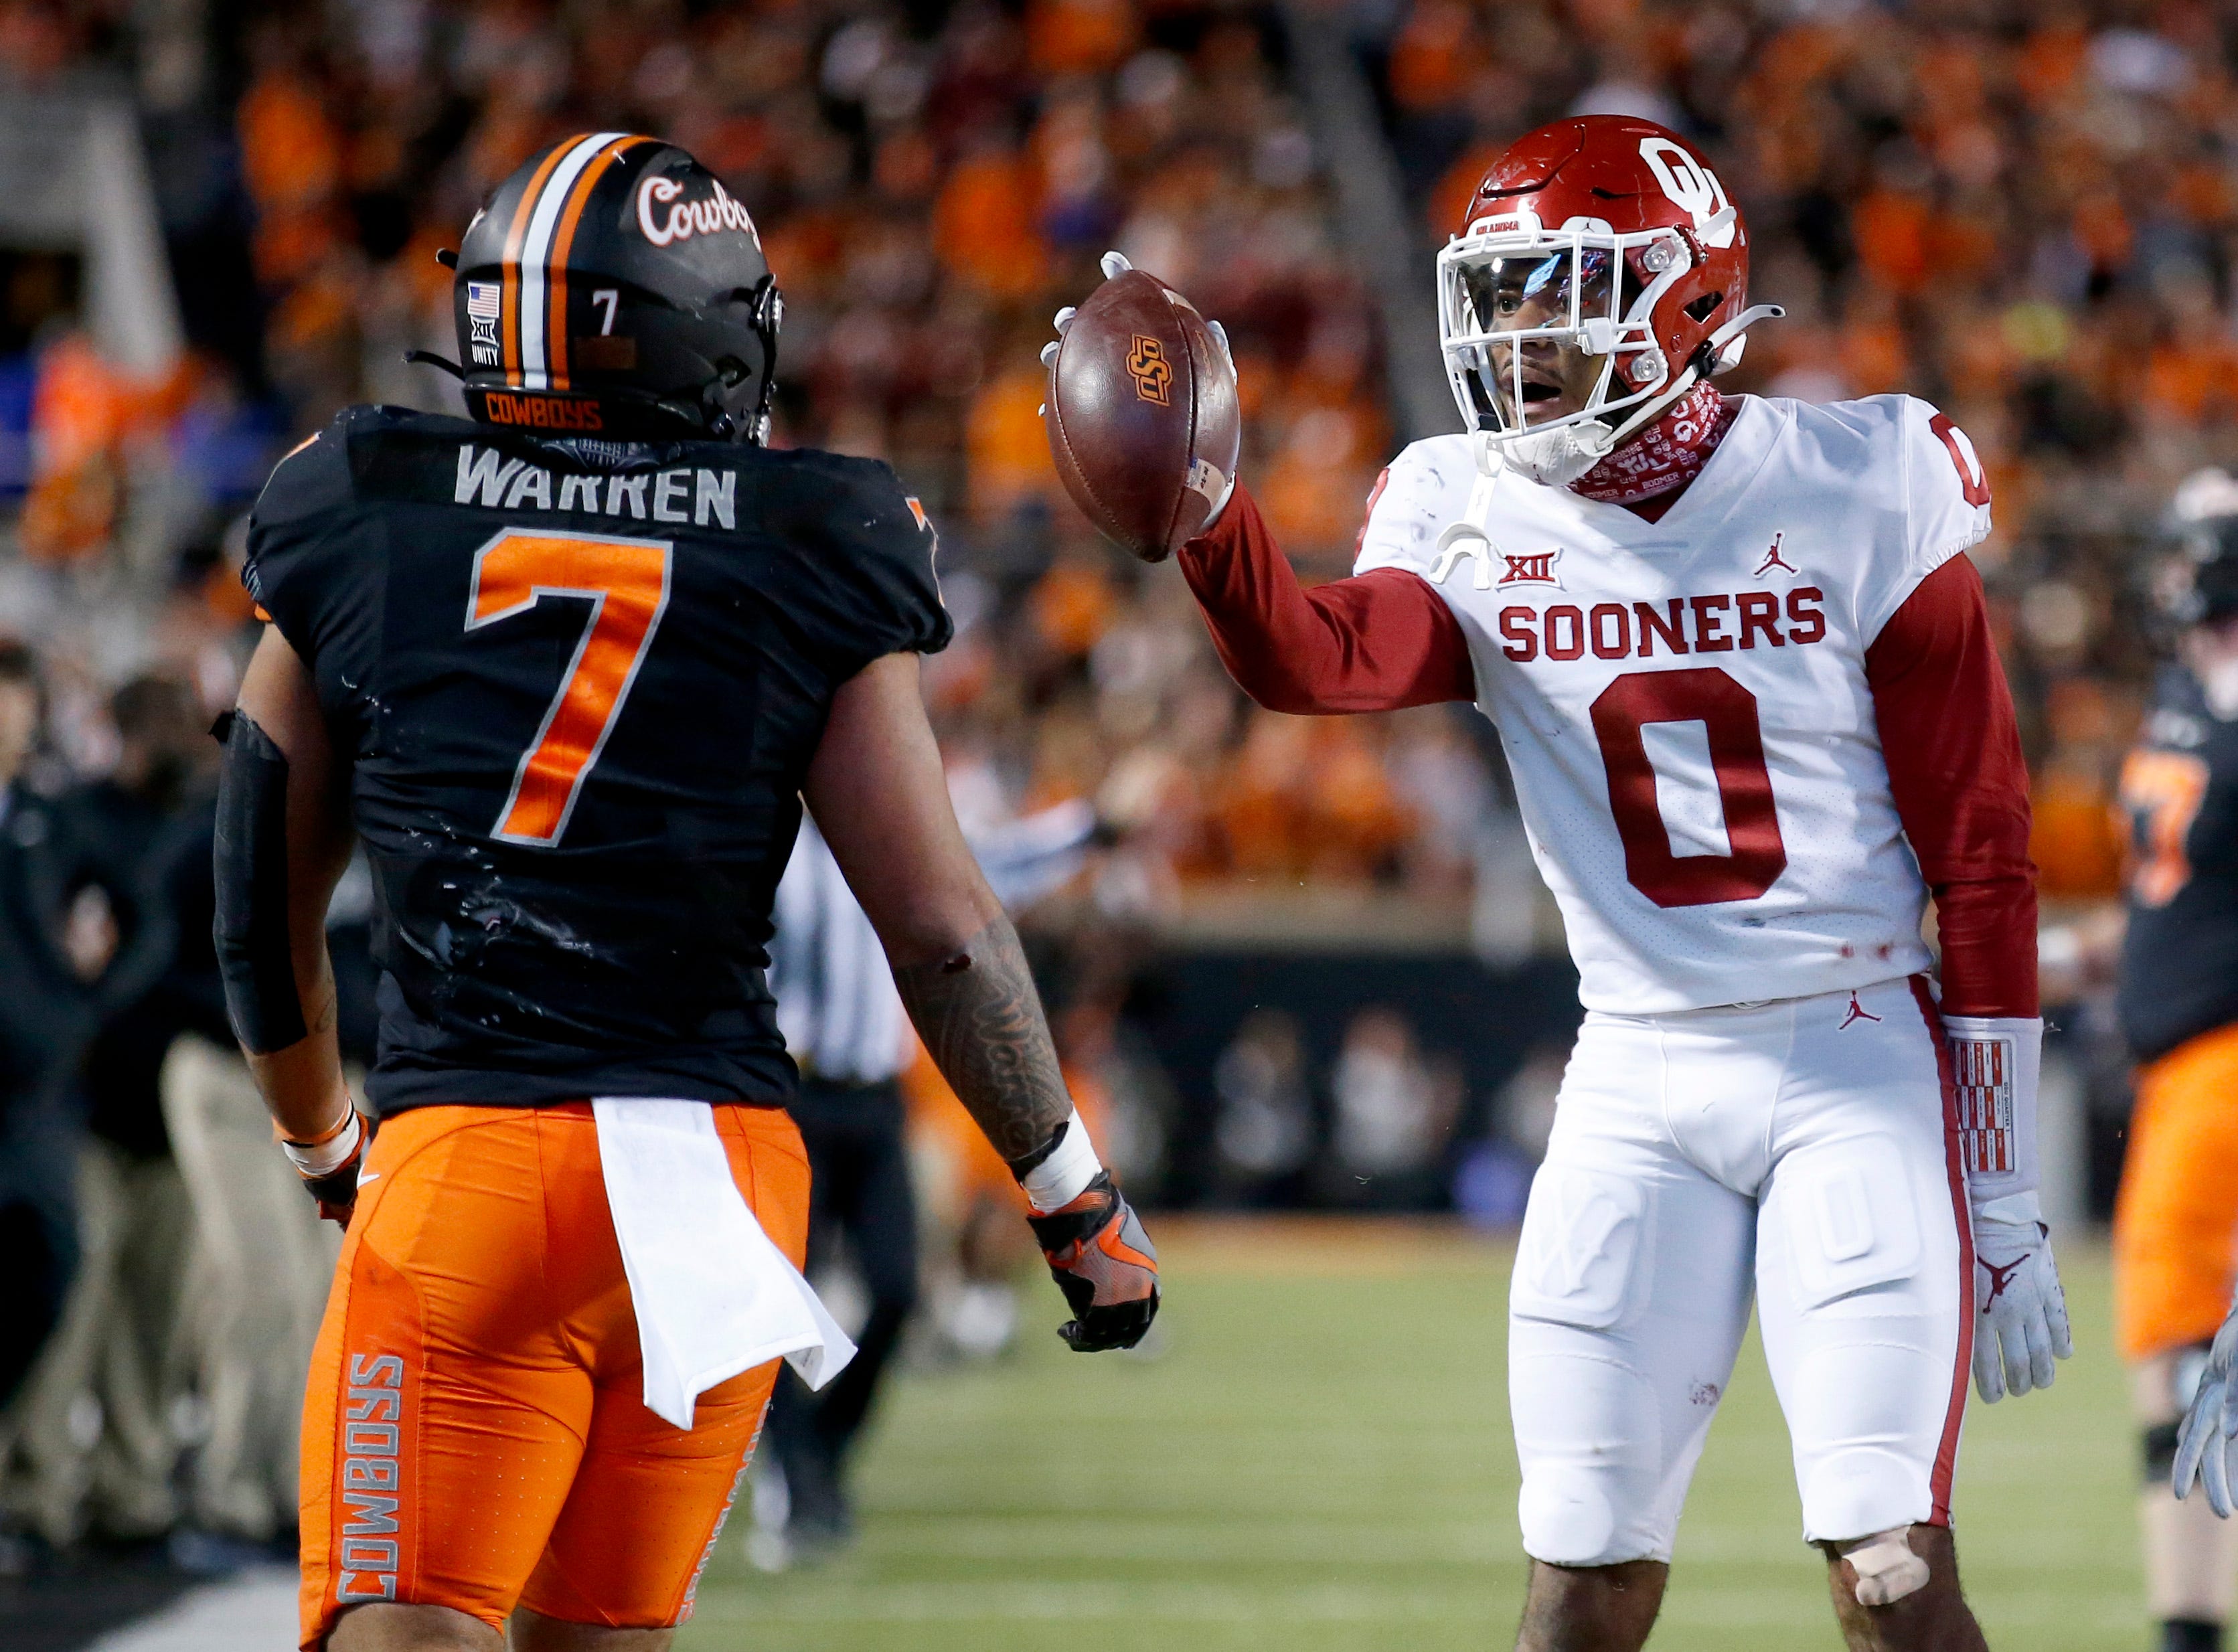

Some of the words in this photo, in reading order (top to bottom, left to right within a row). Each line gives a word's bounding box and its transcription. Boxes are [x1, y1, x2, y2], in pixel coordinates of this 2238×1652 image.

[1639, 137, 1736, 249] OU
[592, 290, 619, 336] 7
[471, 344, 498, 366] UNITY
[485, 392, 603, 430] COWBOYS
[1642, 472, 1680, 489] BOOMER
[1499, 552, 1556, 584] XII
[1499, 586, 1826, 662] SOONERS
[464, 527, 673, 847] 7
[1589, 667, 1787, 908] 0
[336, 1353, 402, 1604] COWBOYS
